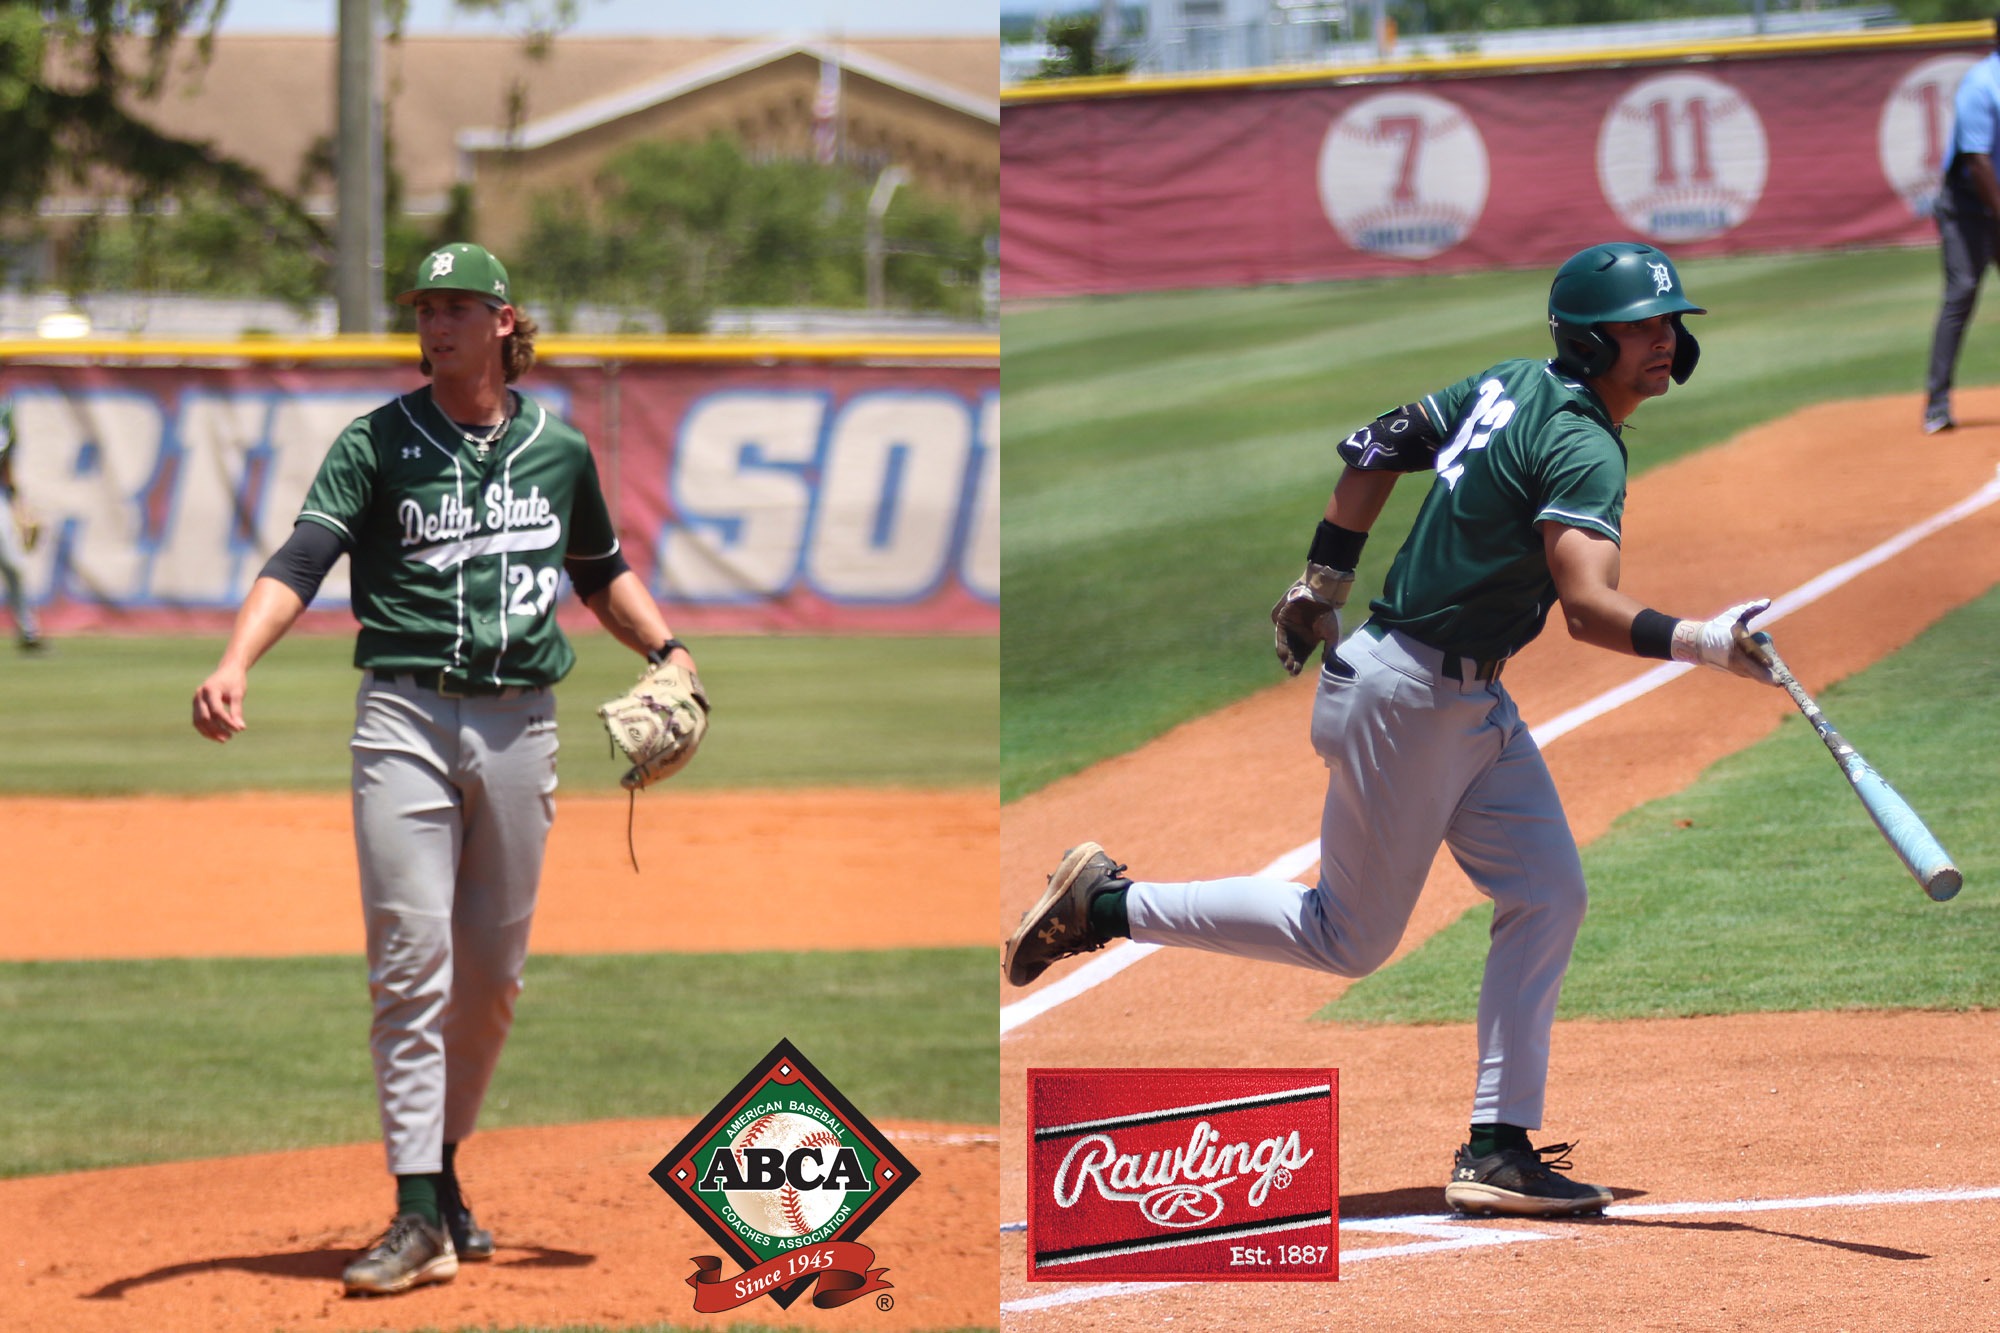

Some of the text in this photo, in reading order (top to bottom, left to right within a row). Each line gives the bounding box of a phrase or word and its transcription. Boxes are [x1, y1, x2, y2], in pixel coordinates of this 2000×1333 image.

[1376, 114, 1422, 204] 7
[1650, 97, 1716, 186] 11
[1646, 261, 1673, 297] D
[399, 483, 551, 547] Delta State
[653, 388, 1000, 606] SO
